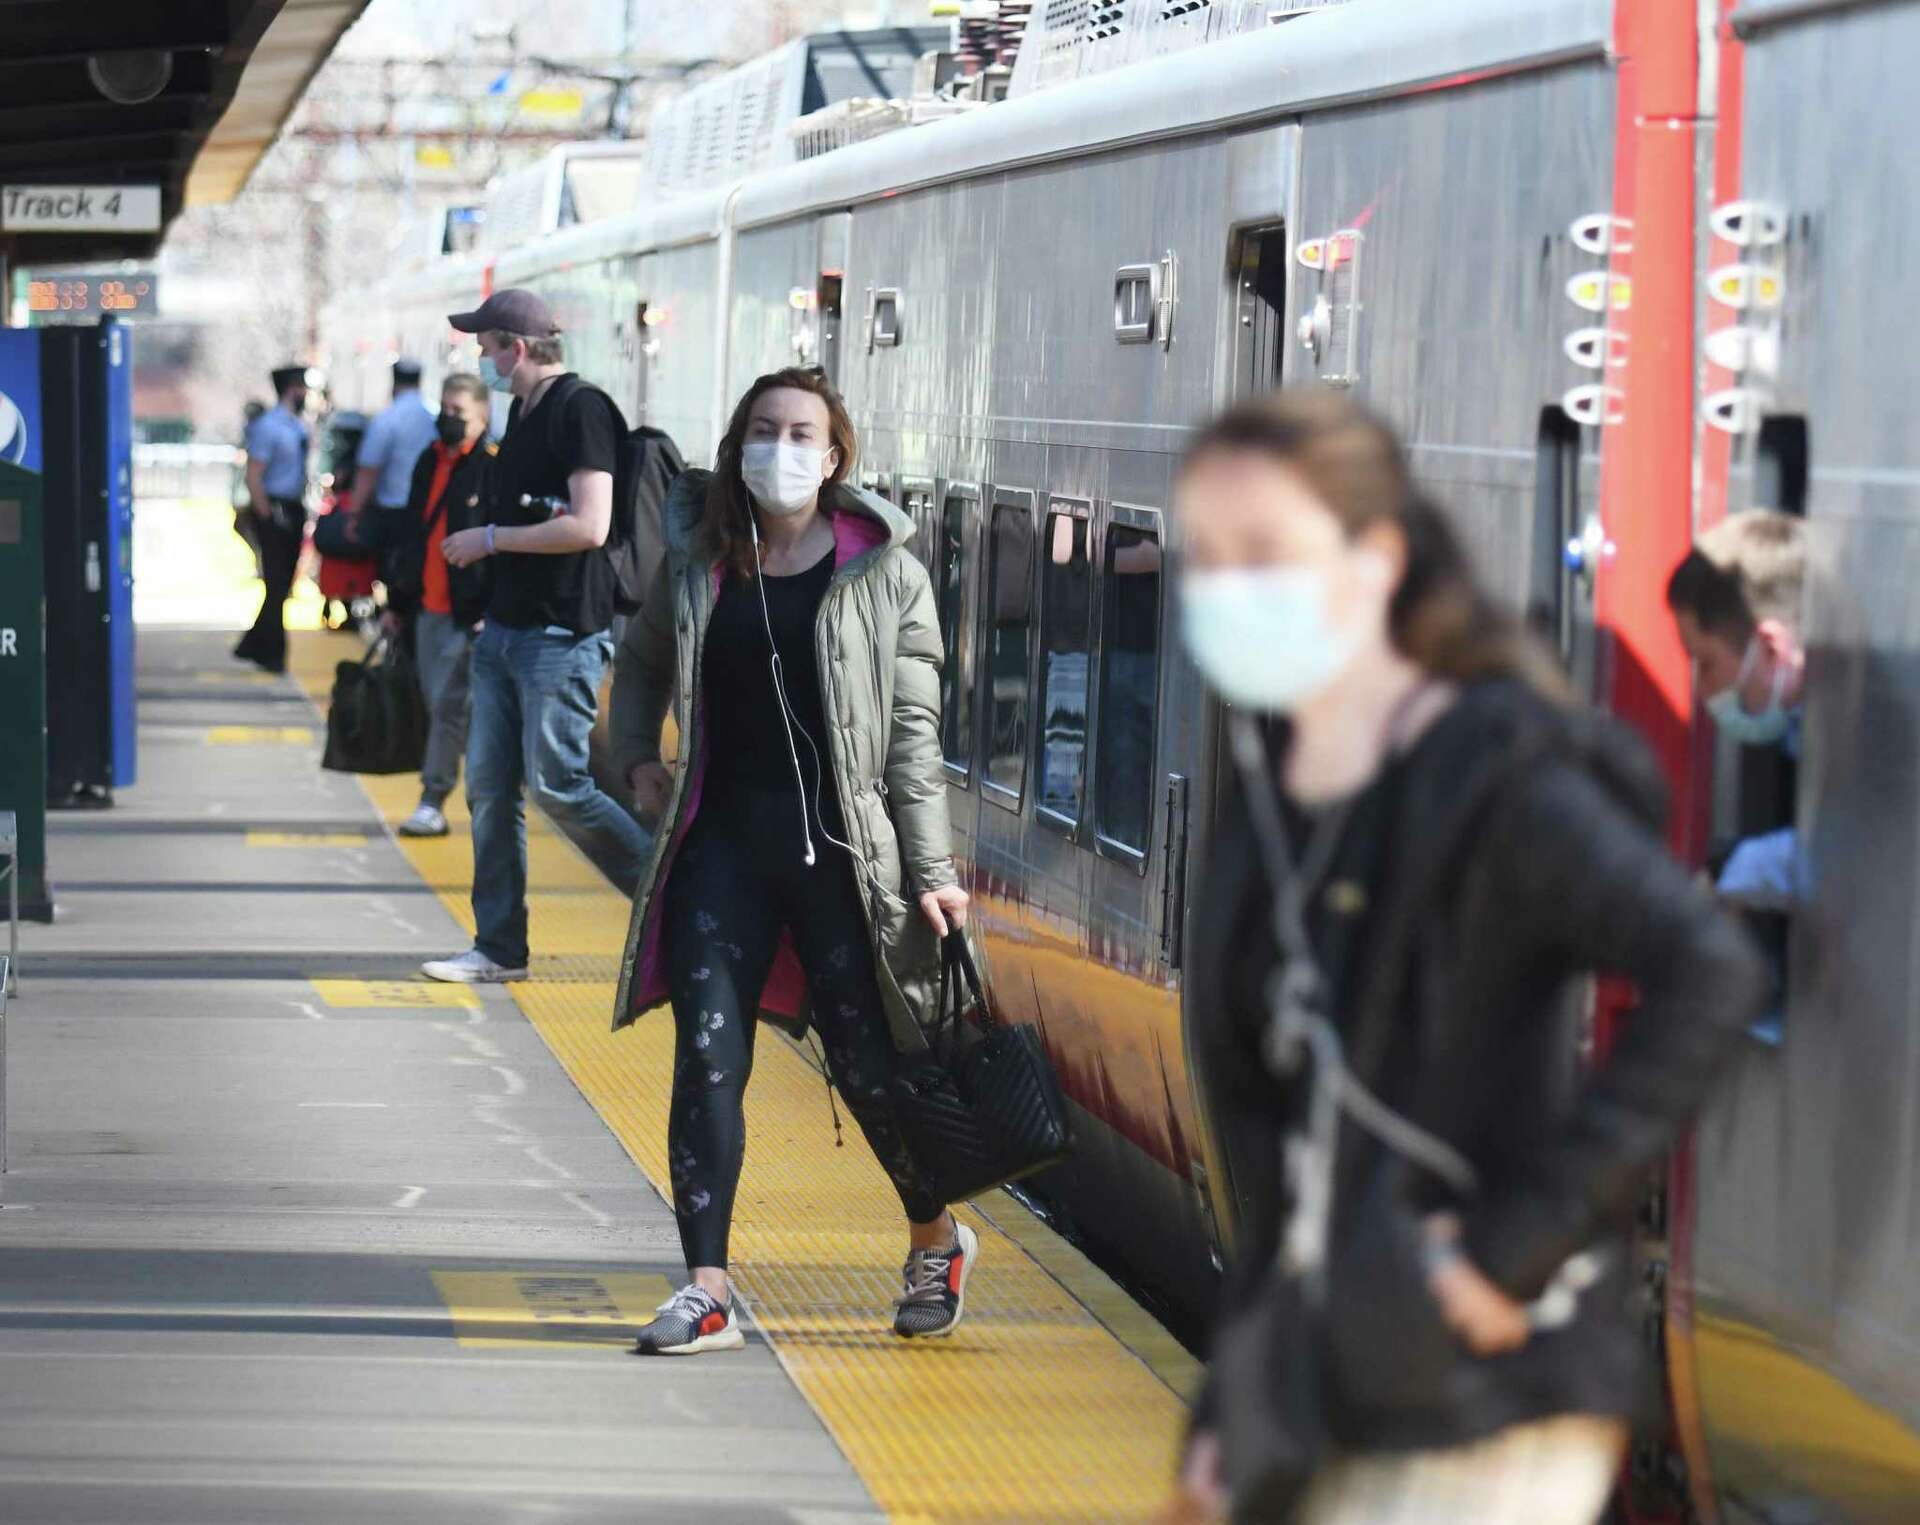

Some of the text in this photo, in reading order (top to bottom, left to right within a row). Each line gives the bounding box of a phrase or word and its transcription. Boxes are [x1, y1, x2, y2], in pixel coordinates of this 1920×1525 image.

[5, 188, 122, 219] Track 4
[0, 628, 18, 657] R
